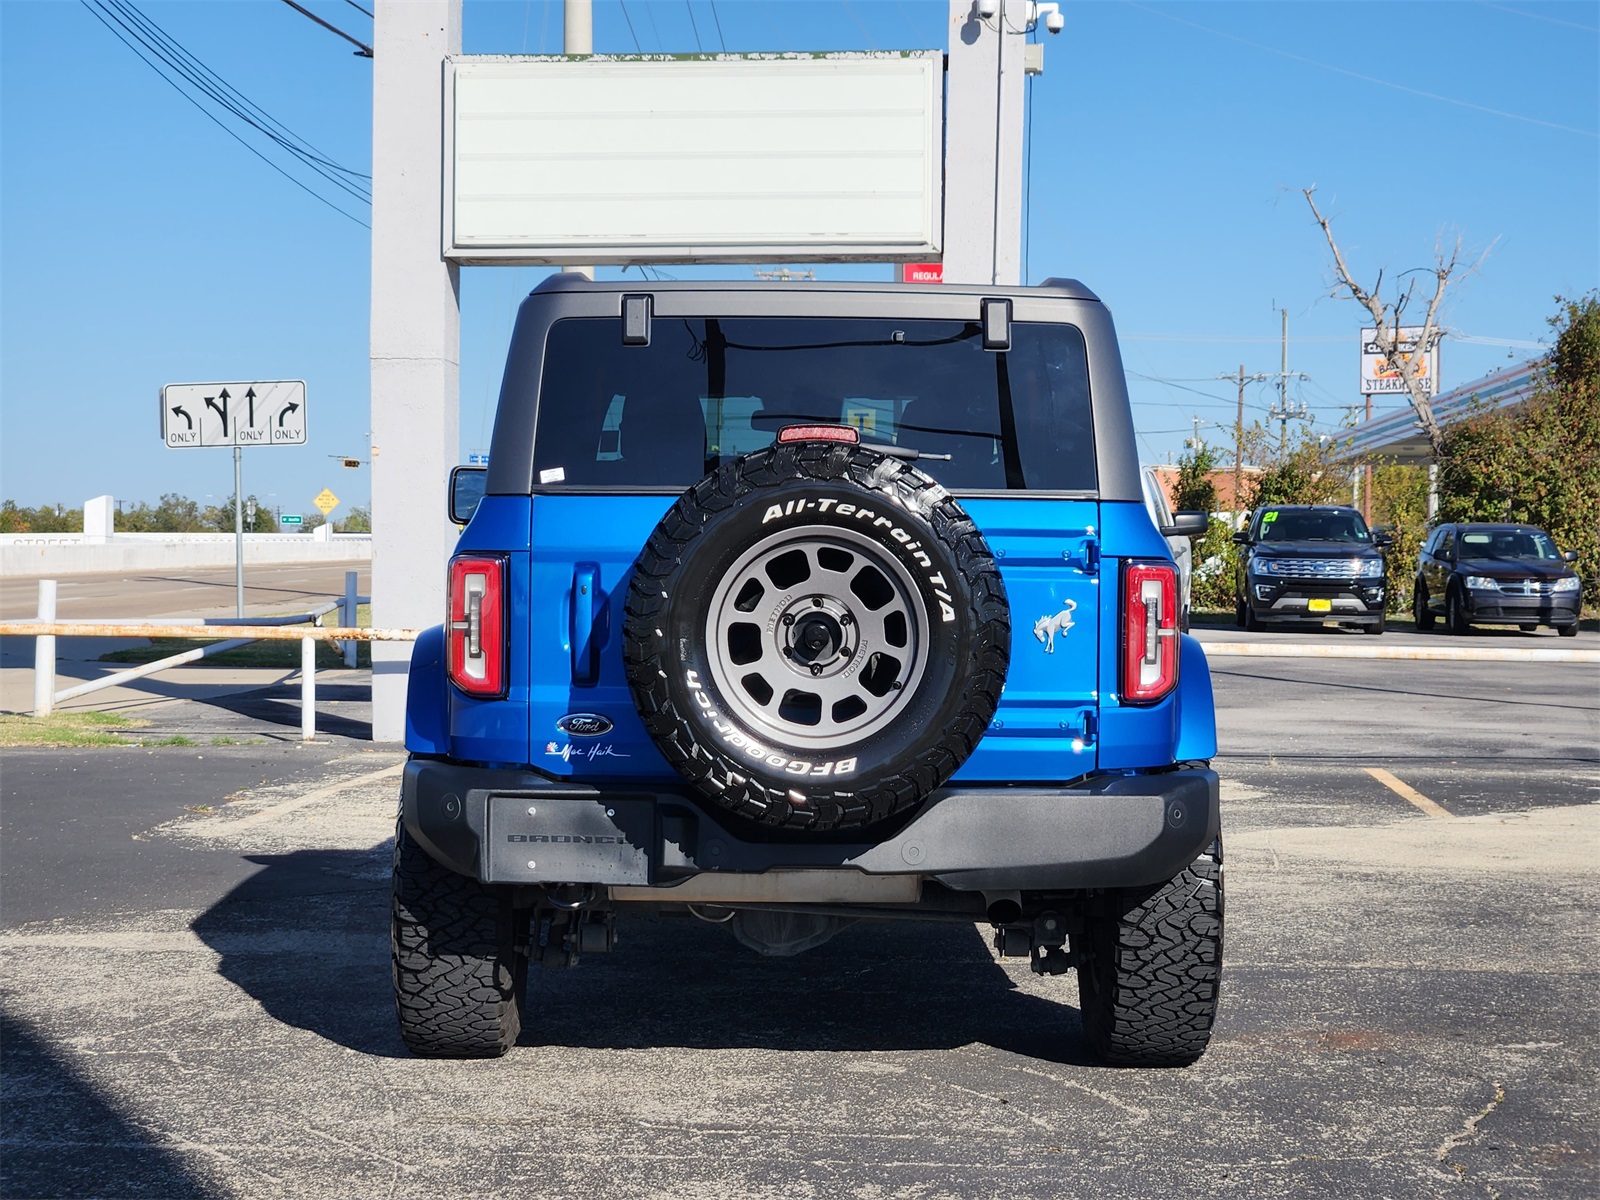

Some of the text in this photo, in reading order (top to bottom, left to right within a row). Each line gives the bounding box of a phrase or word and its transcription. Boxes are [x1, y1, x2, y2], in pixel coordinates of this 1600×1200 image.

[170, 431, 197, 443] ONLY
[239, 430, 265, 441] ONLY
[274, 429, 302, 440] ONLY
[1262, 511, 1279, 522] 21
[761, 497, 956, 623] All-Terrain T/A
[765, 593, 793, 635] METHOD
[840, 638, 869, 680] METHOD
[685, 668, 859, 777] BFGoodrich
